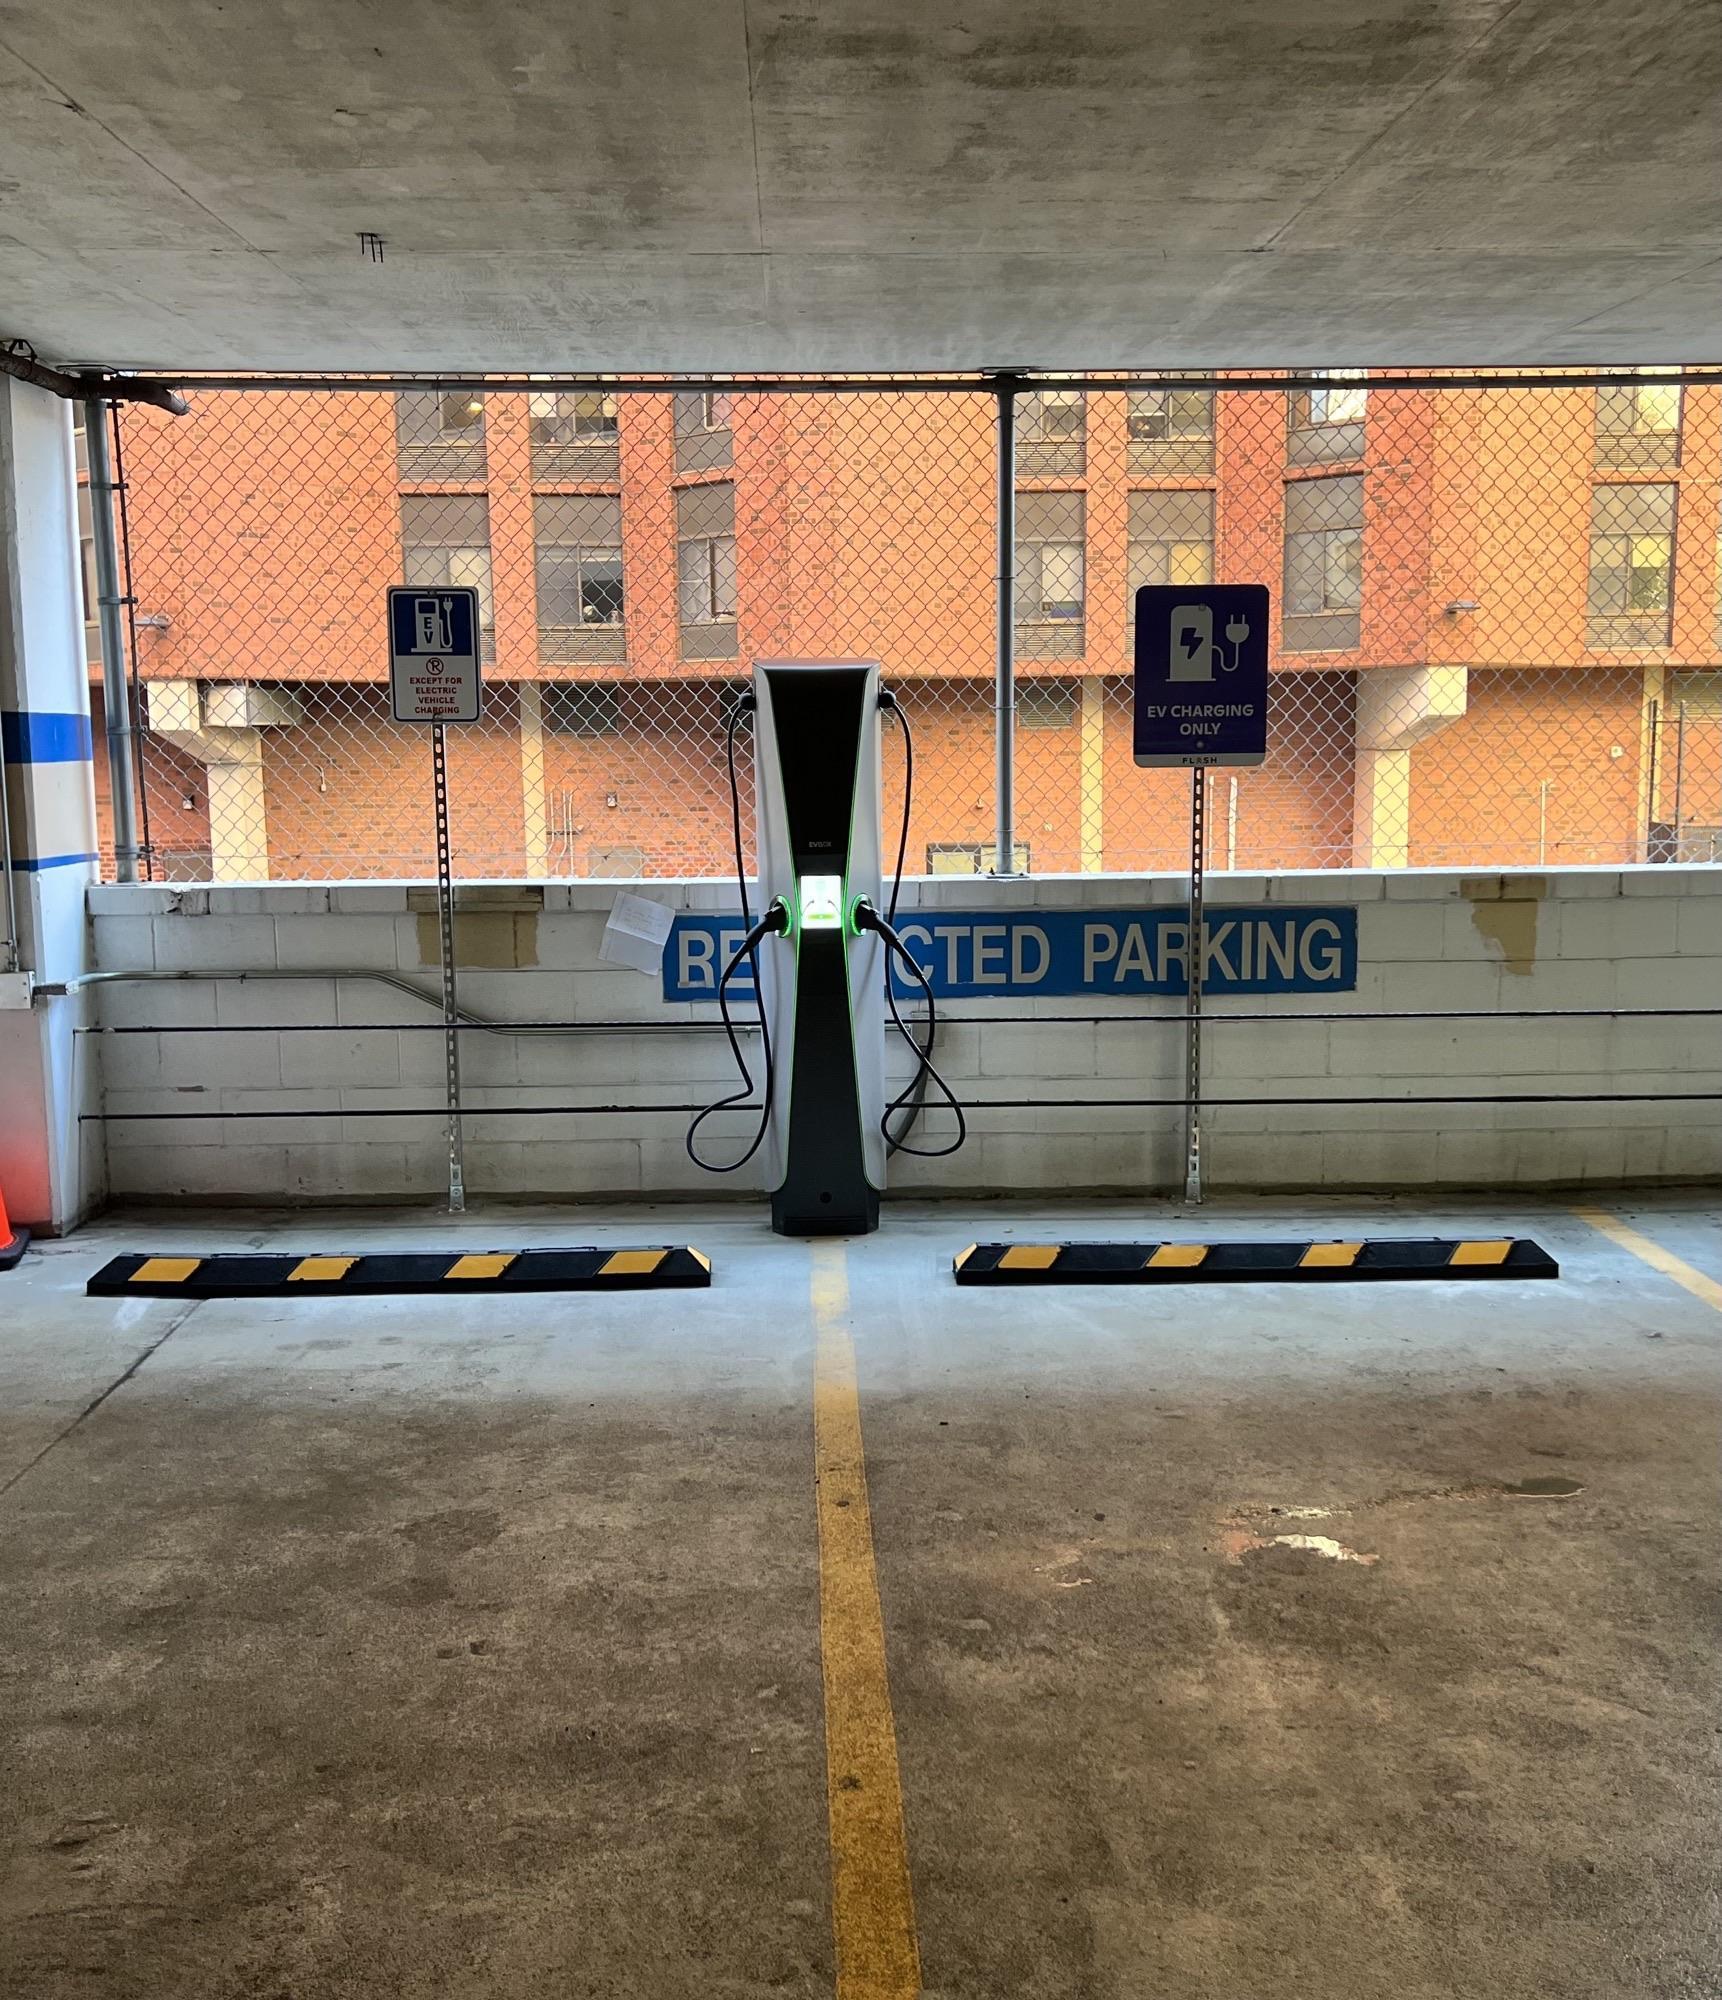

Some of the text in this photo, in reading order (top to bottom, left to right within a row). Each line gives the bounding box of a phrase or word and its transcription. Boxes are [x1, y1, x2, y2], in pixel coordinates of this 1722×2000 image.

[415, 686, 457, 694] ELECTRIC
[414, 706, 460, 714] CHARGING
[1147, 704, 1254, 718] EV CHARGING
[1179, 723, 1221, 735] ONLY
[677, 918, 1342, 990] RECTED PARKING
